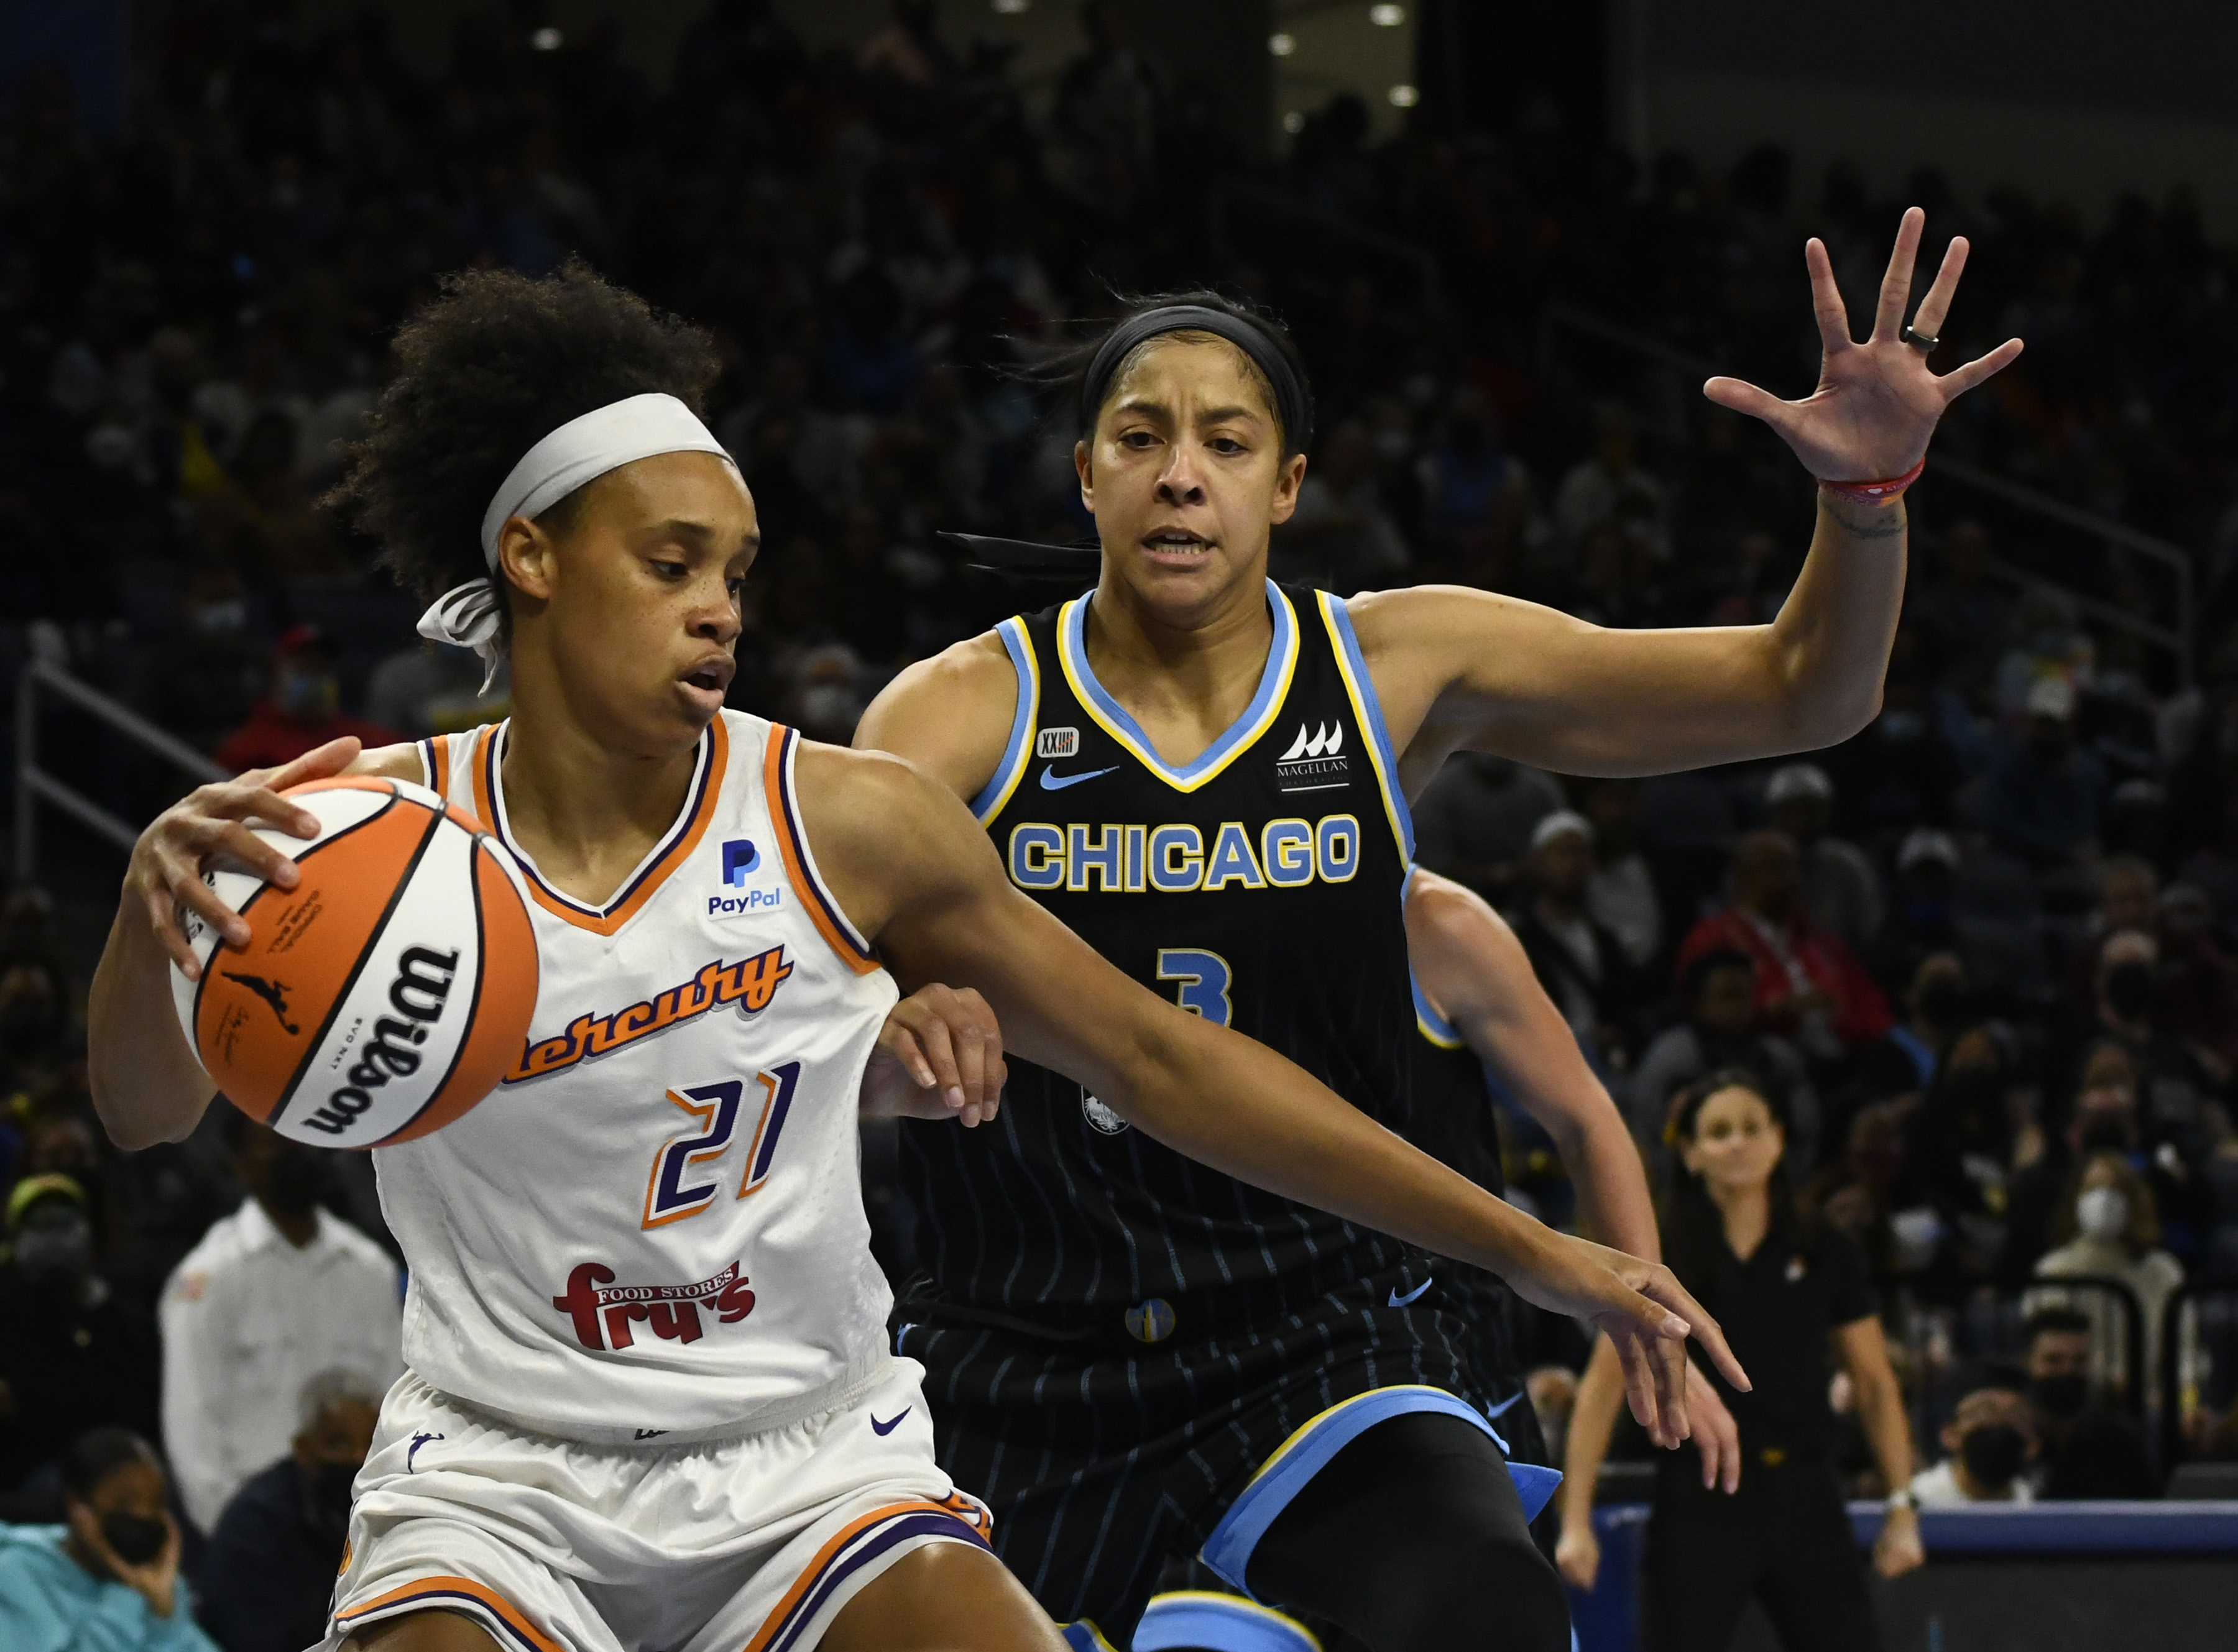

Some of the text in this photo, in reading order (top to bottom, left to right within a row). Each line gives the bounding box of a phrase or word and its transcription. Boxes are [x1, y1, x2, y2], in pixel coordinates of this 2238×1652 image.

[1278, 760, 1348, 777] MAGELLAN
[1008, 814, 1360, 893] CHICAGO
[709, 888, 780, 915] PayPal
[502, 944, 794, 1084] ercury
[1156, 948, 1232, 1028] 3
[301, 945, 461, 1134] Wilson
[346, 1017, 362, 1042] EVO
[641, 1058, 806, 1229] 21
[596, 1268, 734, 1304] FOOD STORES
